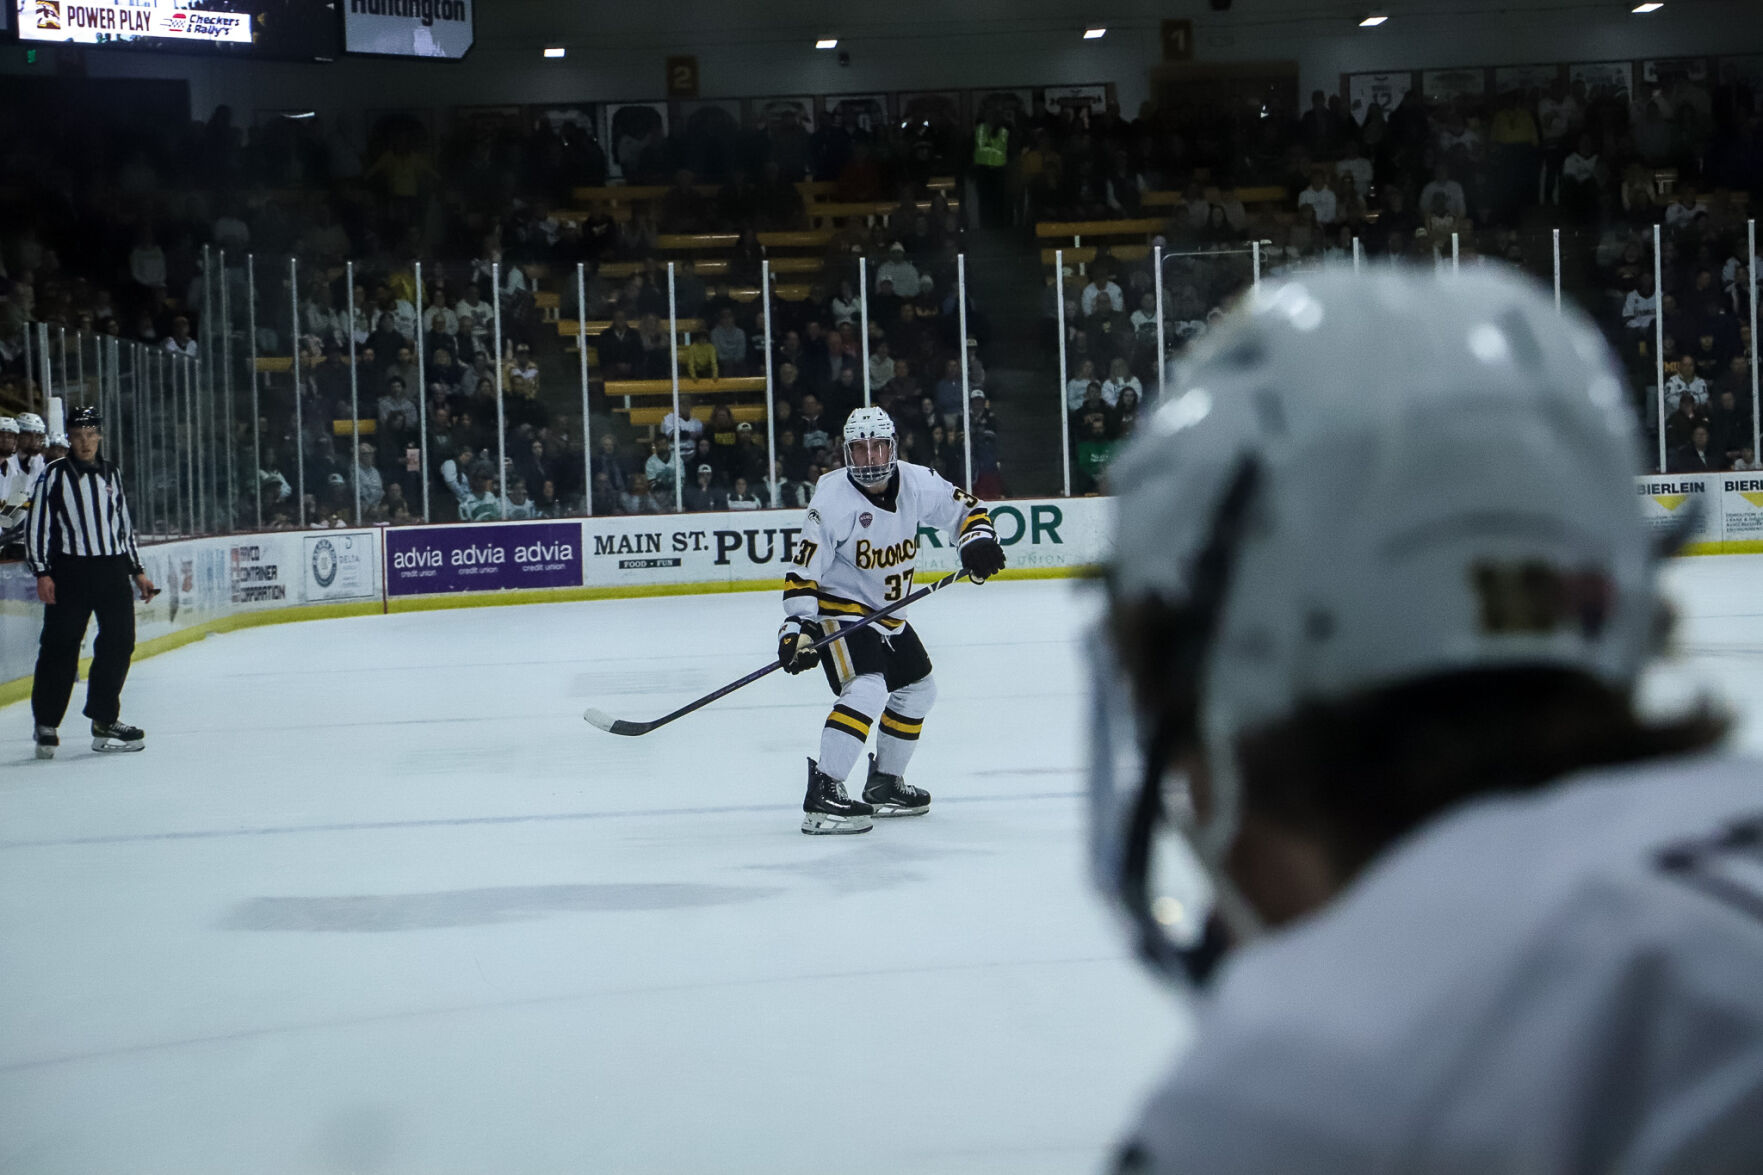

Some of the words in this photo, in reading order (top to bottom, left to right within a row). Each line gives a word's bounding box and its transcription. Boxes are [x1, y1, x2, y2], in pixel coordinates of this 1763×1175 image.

[67, 6, 115, 29] POWER
[119, 10, 151, 31] PLAY
[190, 14, 240, 26] Checkers
[187, 24, 192, 32] &
[194, 24, 233, 37] Rally's
[1170, 29, 1185, 52] 1
[673, 66, 692, 88] 2
[1637, 482, 1705, 495] BIERLEIN
[514, 541, 573, 563] advia
[594, 533, 662, 555] MAIN
[672, 531, 709, 552] ST.
[793, 539, 818, 568] 37
[856, 539, 917, 569] Bronc
[394, 546, 443, 569] advia
[451, 544, 505, 566] advia
[623, 560, 647, 568] FOOD
[656, 559, 673, 567] FUN
[401, 570, 418, 578] credit
[419, 569, 437, 577] union
[458, 567, 478, 575] credit
[479, 566, 498, 574] union
[522, 564, 543, 572] credit
[545, 563, 566, 571] union
[884, 567, 914, 601] 37
